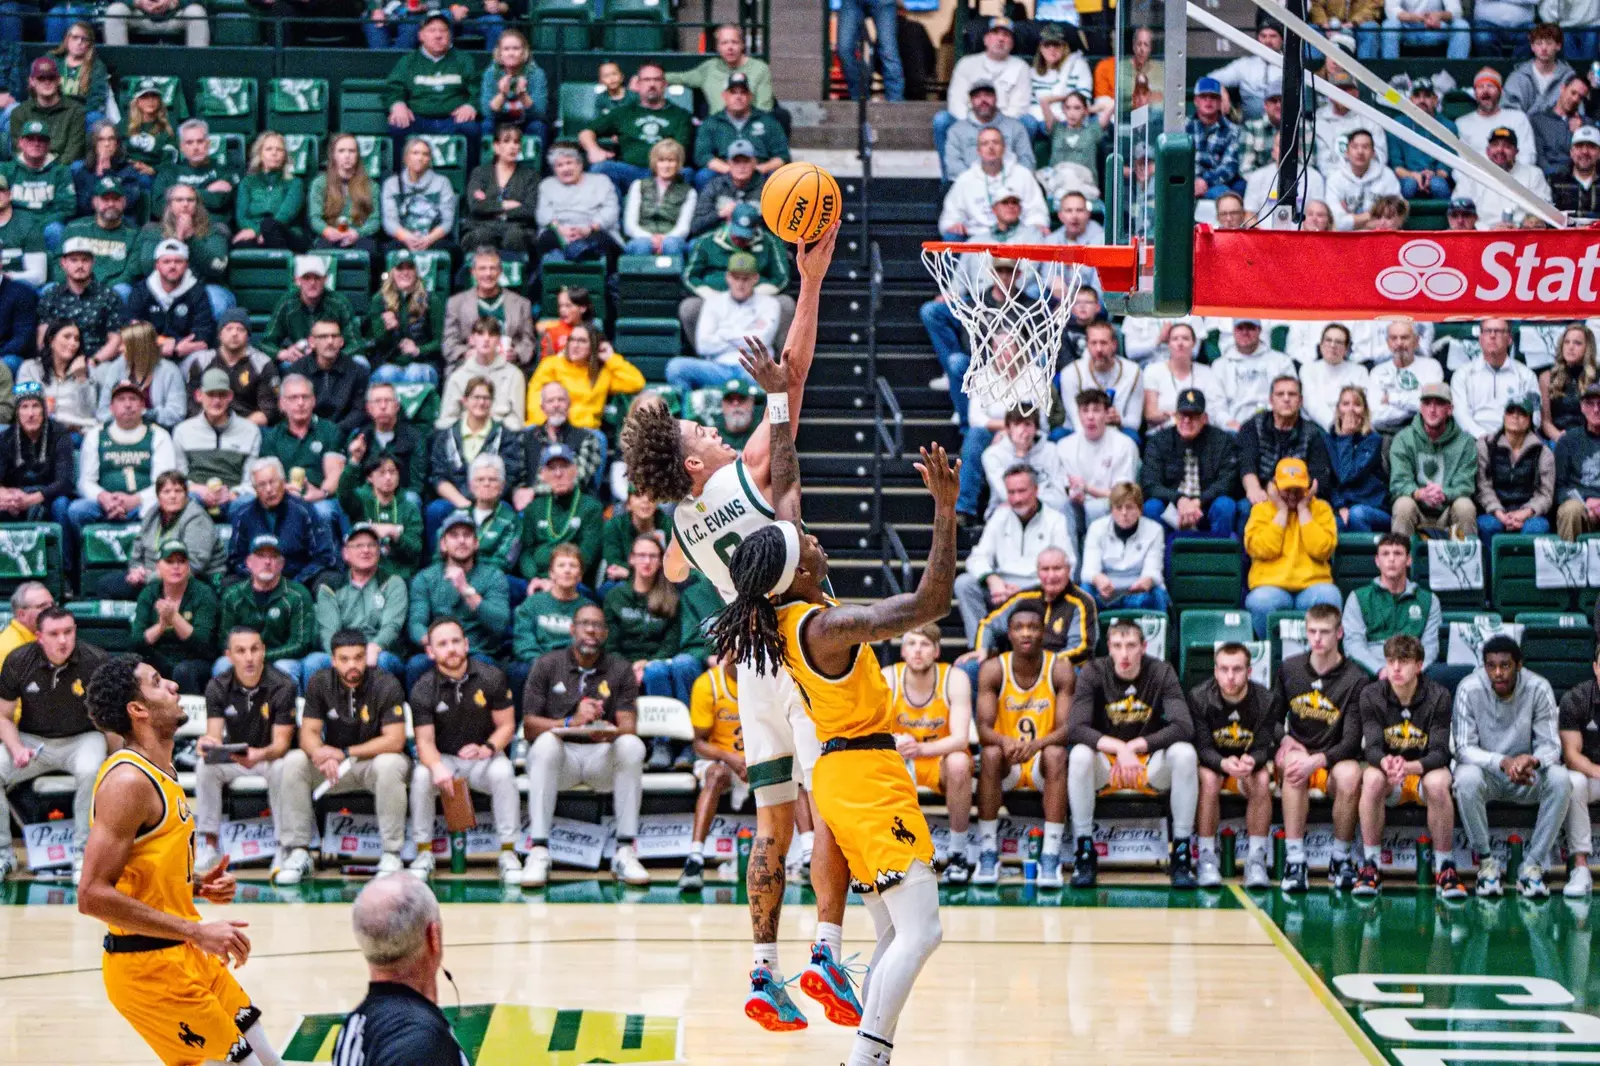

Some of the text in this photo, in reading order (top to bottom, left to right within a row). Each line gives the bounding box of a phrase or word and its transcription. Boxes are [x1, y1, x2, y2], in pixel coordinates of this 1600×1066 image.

[787, 196, 809, 232] NCAA
[1475, 241, 1600, 302] Stat
[684, 498, 746, 546] K.C. EVANS
[1111, 844, 1153, 853] TOYOTA
